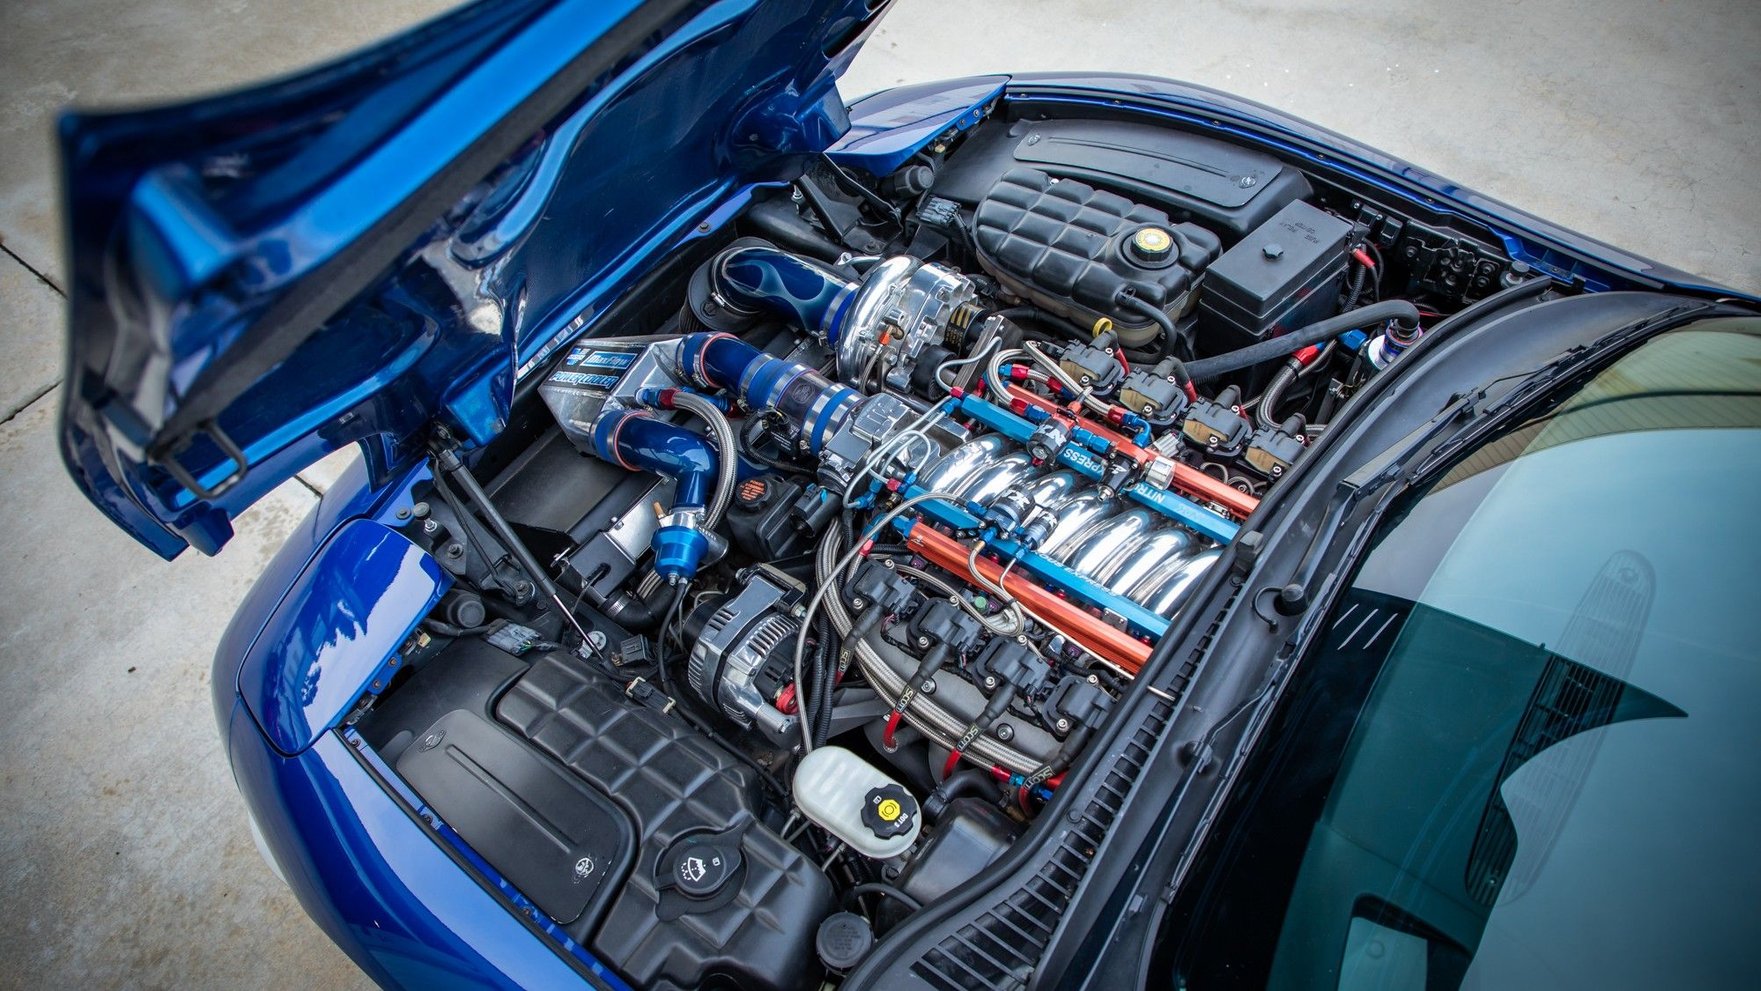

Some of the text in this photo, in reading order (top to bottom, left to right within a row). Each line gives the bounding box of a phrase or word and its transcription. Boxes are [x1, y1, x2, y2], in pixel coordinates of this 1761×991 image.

[1063, 448, 1106, 476] XPRESS
[896, 687, 915, 713] SCOTT
[957, 725, 979, 750] SCOTT
[1024, 767, 1054, 790] SCOTT
